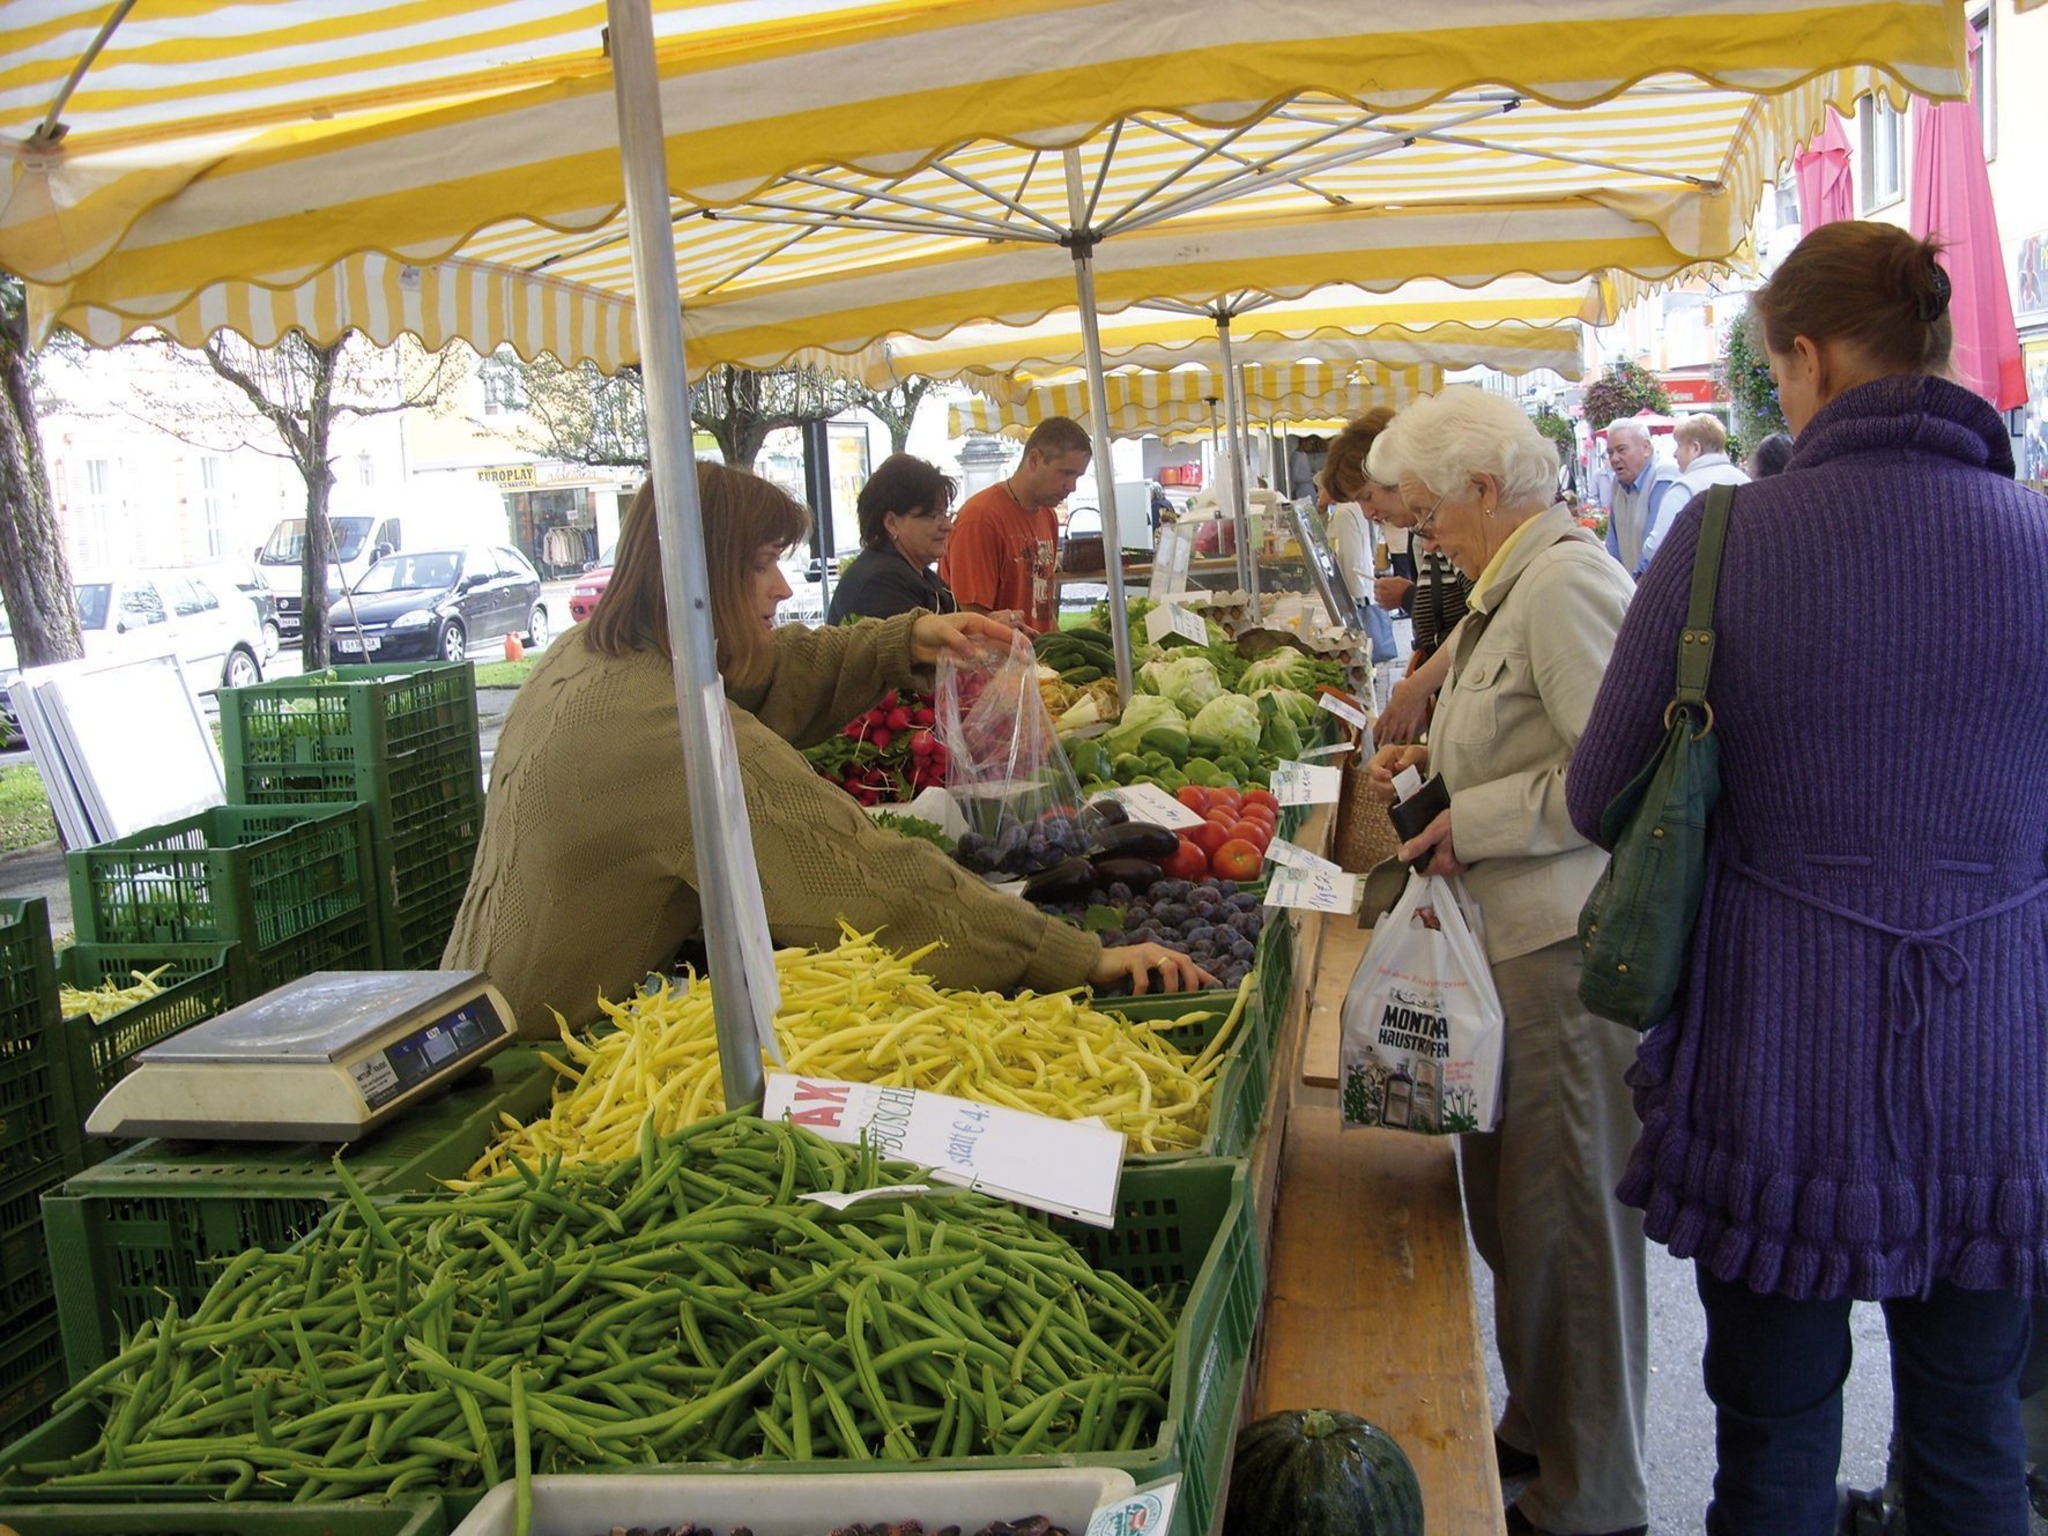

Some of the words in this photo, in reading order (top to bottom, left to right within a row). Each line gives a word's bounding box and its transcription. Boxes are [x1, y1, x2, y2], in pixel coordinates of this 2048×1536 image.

[478, 468, 534, 482] EUROPLAY
[953, 1120, 985, 1136] €
[944, 1131, 978, 1167] statt
